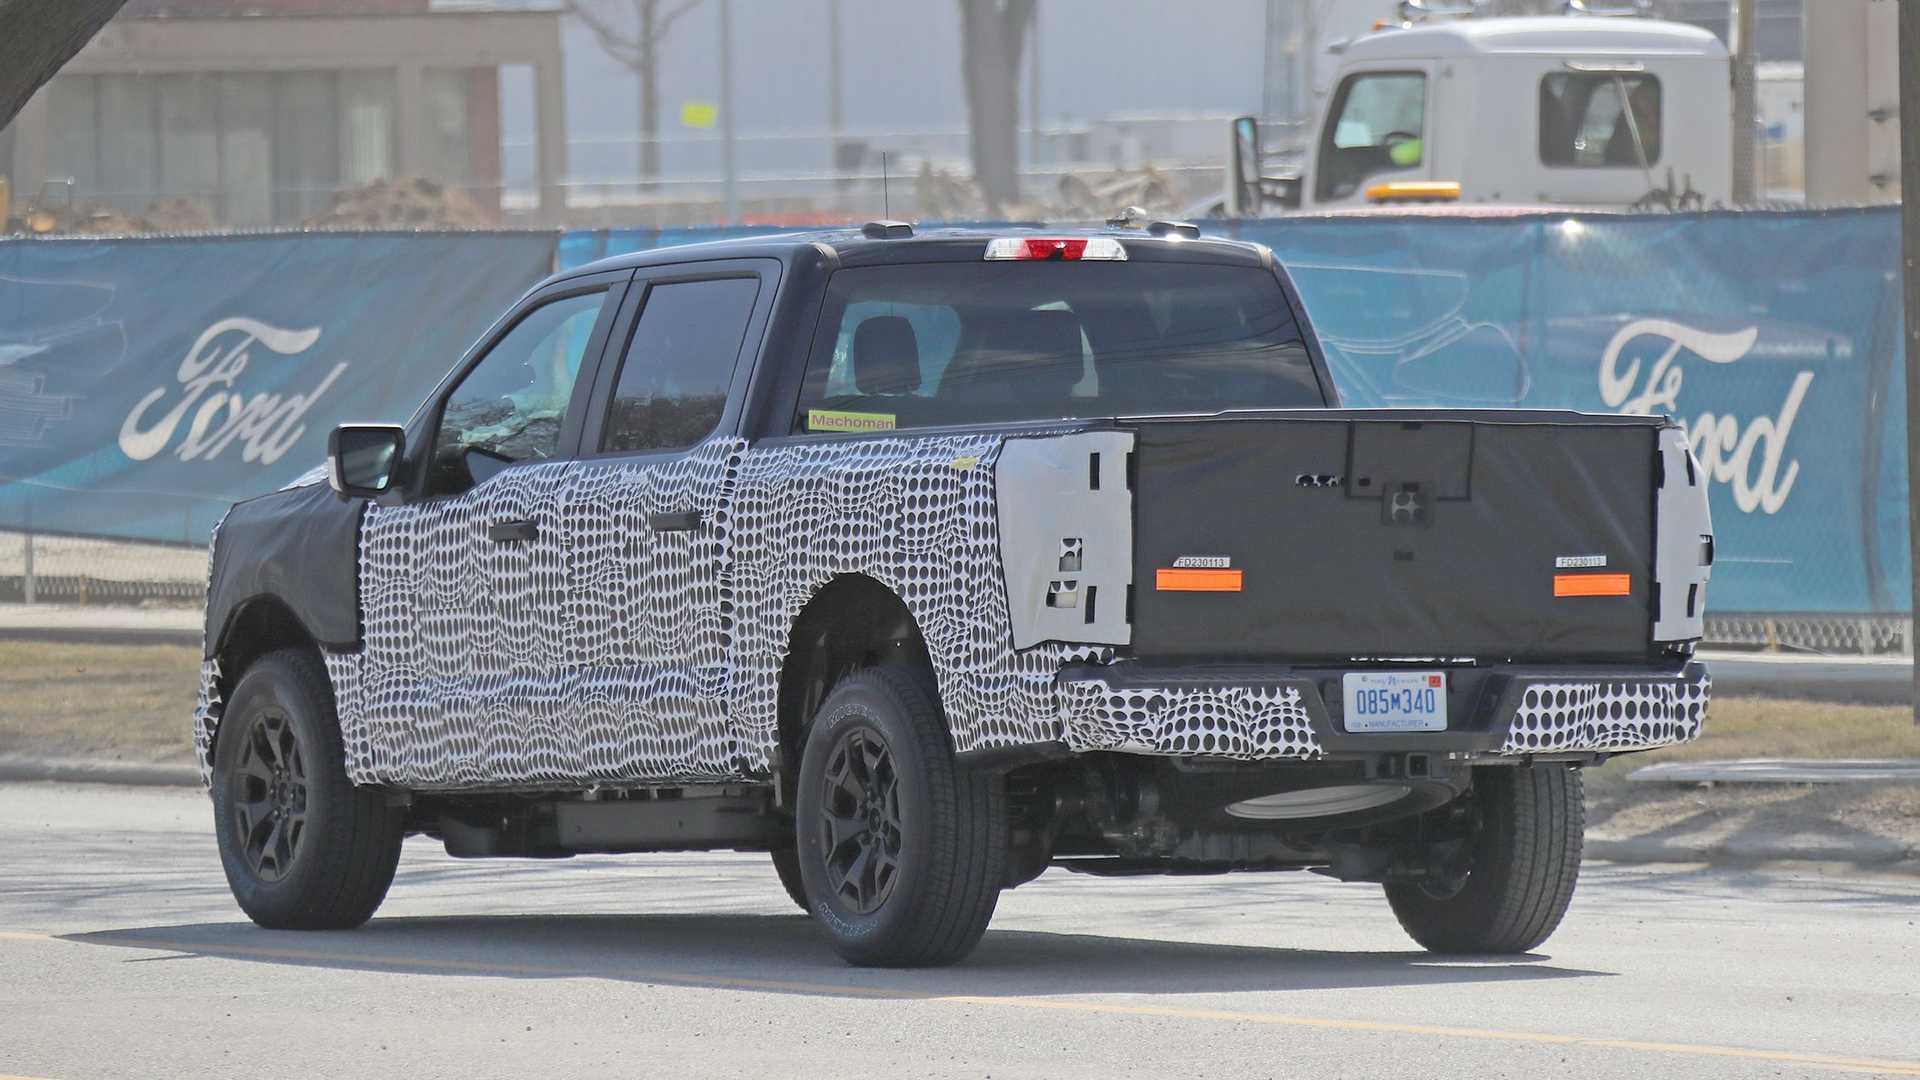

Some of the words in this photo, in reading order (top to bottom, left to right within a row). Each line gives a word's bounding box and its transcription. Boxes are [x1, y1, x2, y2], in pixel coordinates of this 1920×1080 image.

[118, 317, 349, 465] Ford
[811, 414, 895, 430] Machoman
[1598, 319, 1815, 515] Frd
[1178, 558, 1224, 567] FD230113
[1356, 688, 1436, 715] 085M340
